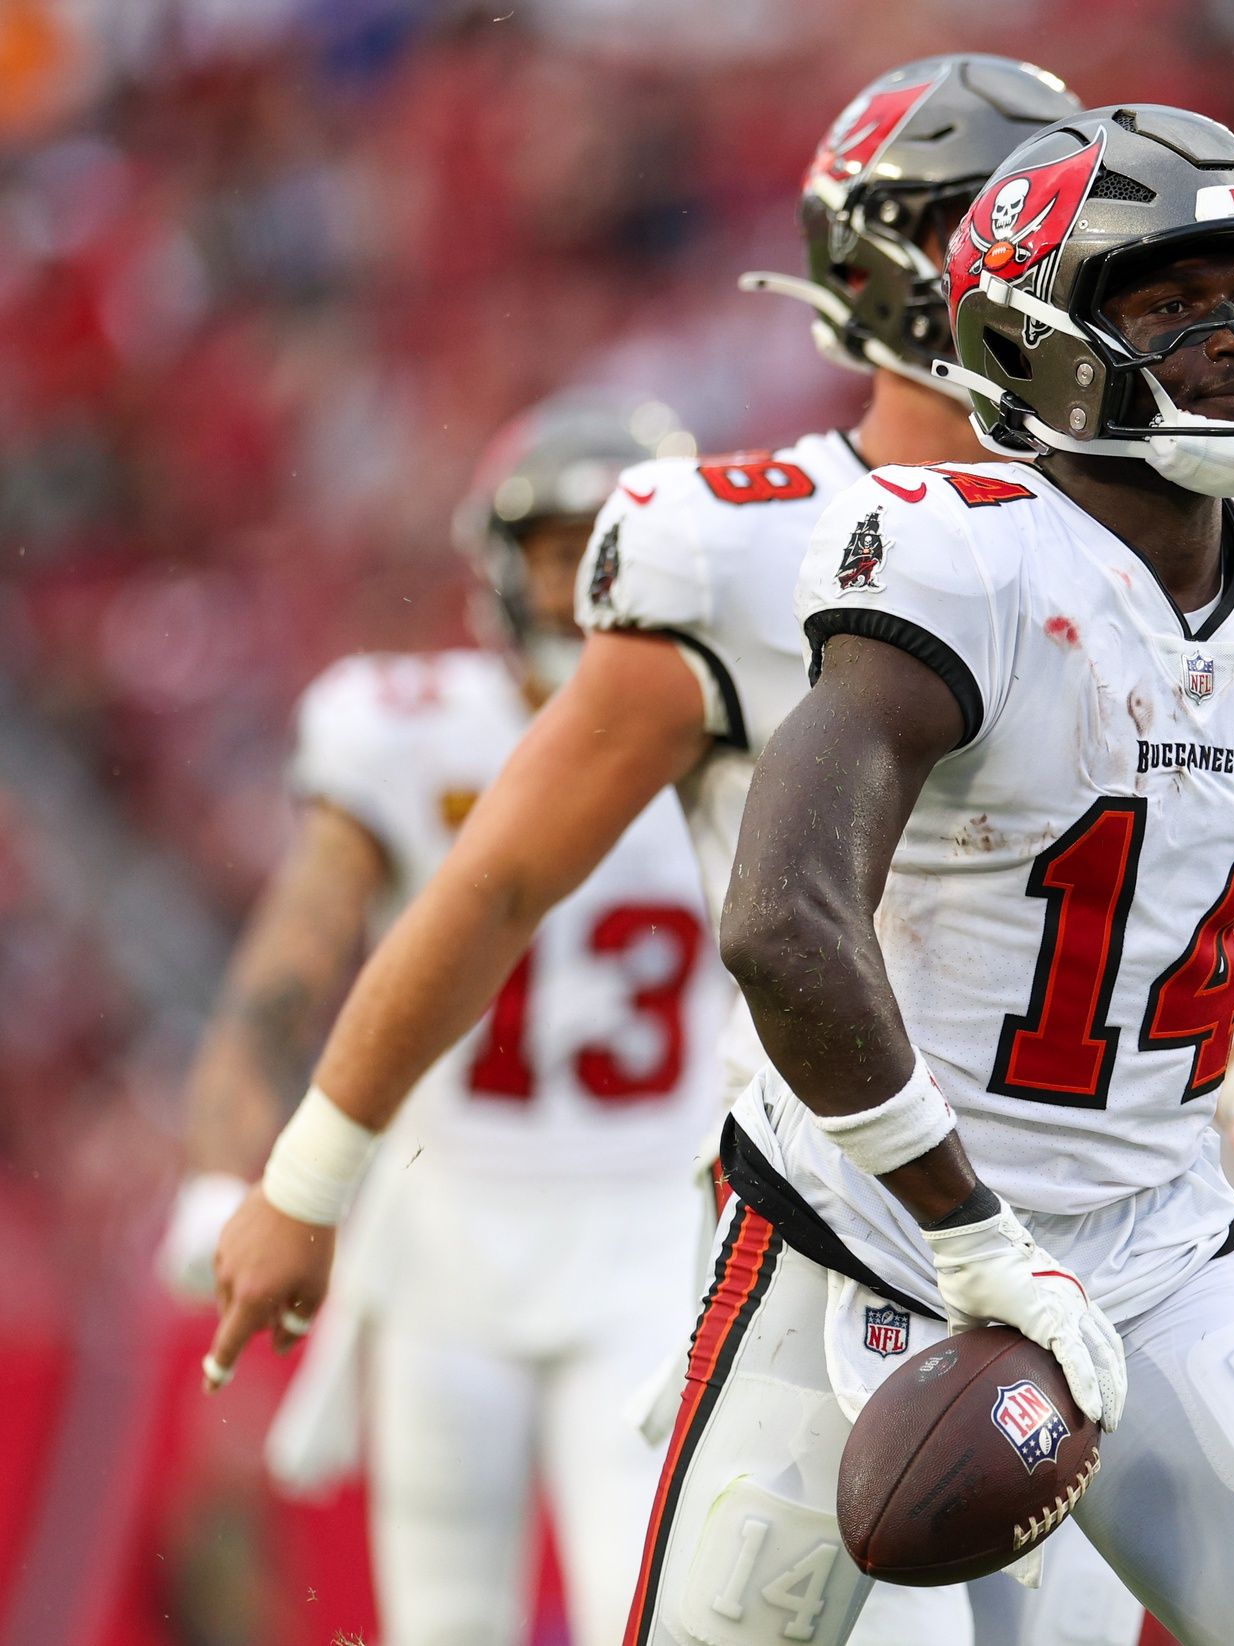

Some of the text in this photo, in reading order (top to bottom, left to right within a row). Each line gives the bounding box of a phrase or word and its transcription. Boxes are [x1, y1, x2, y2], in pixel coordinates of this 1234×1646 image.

[1190, 674, 1212, 694] NFL
[464, 902, 702, 1103] 13
[868, 1325, 904, 1353] NFL
[1000, 1387, 1050, 1438] NFL
[711, 1517, 839, 1641] 14
